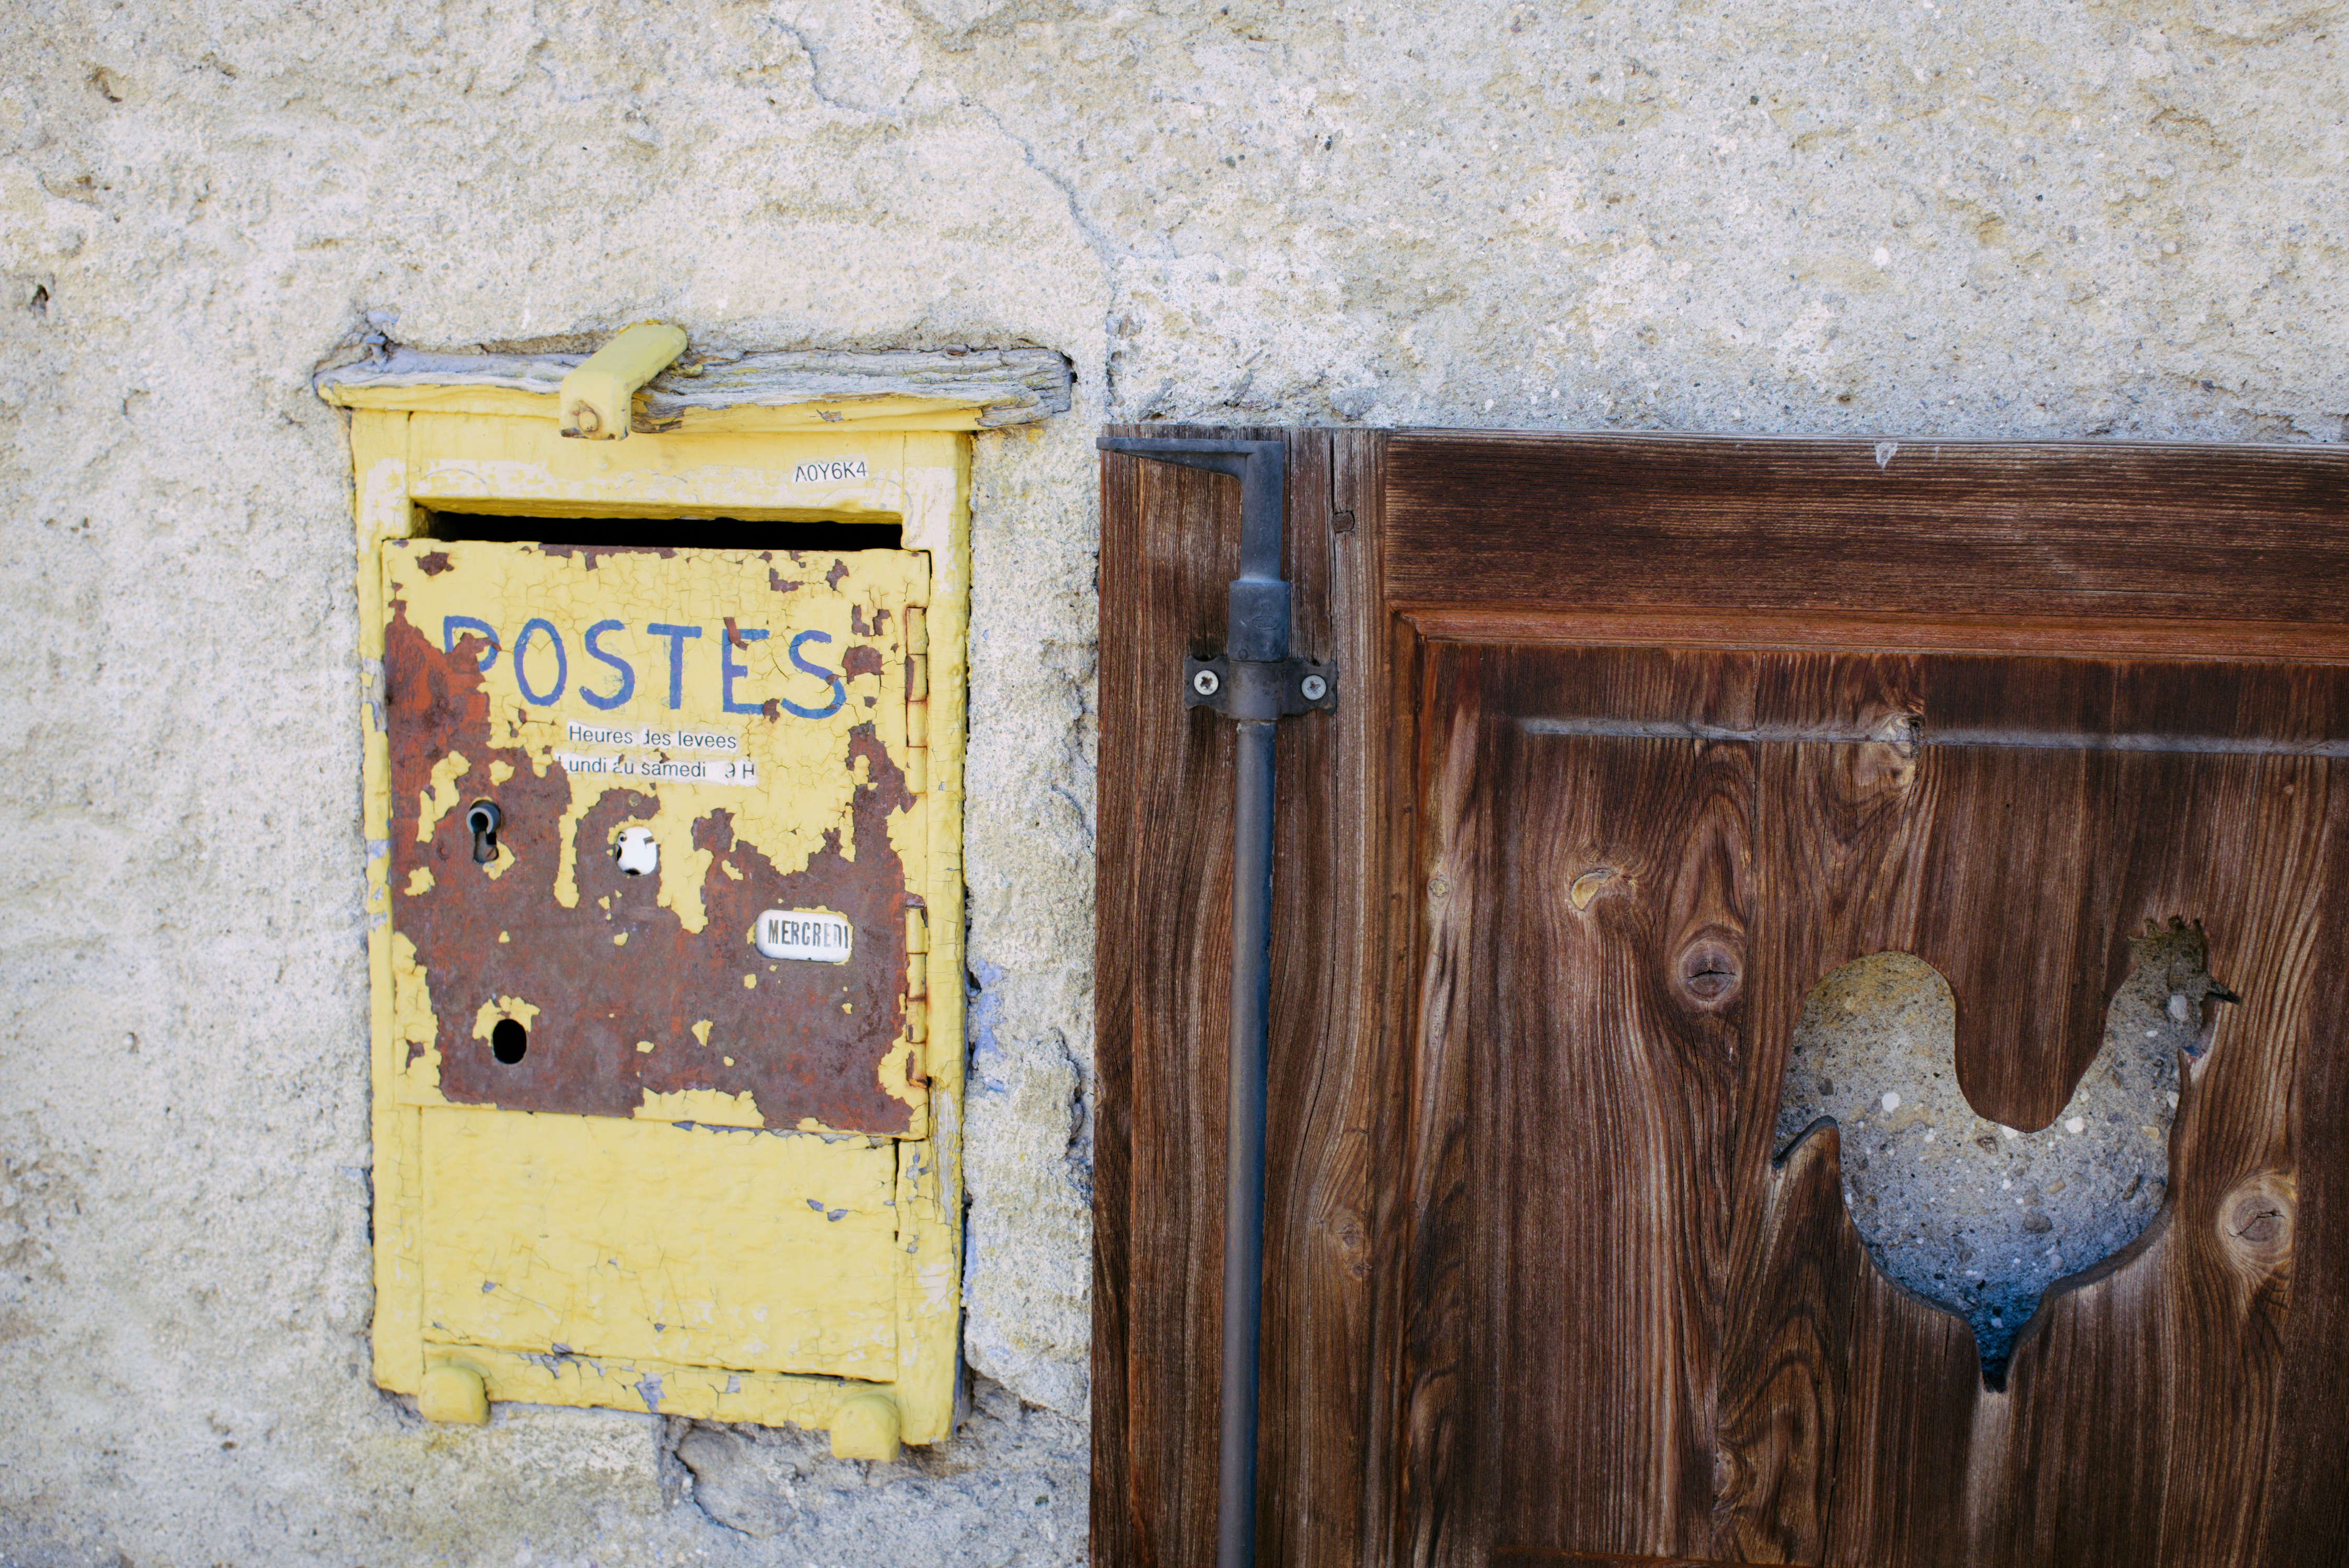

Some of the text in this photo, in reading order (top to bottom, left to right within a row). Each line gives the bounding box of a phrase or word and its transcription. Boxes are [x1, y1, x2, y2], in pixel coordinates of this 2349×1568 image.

[443, 615, 846, 719] POSTES
[569, 726, 632, 744] Heures
[678, 730, 736, 748] levees
[642, 761, 705, 777] samedi
[743, 763, 755, 779] H
[768, 919, 849, 949] MERCREDI
